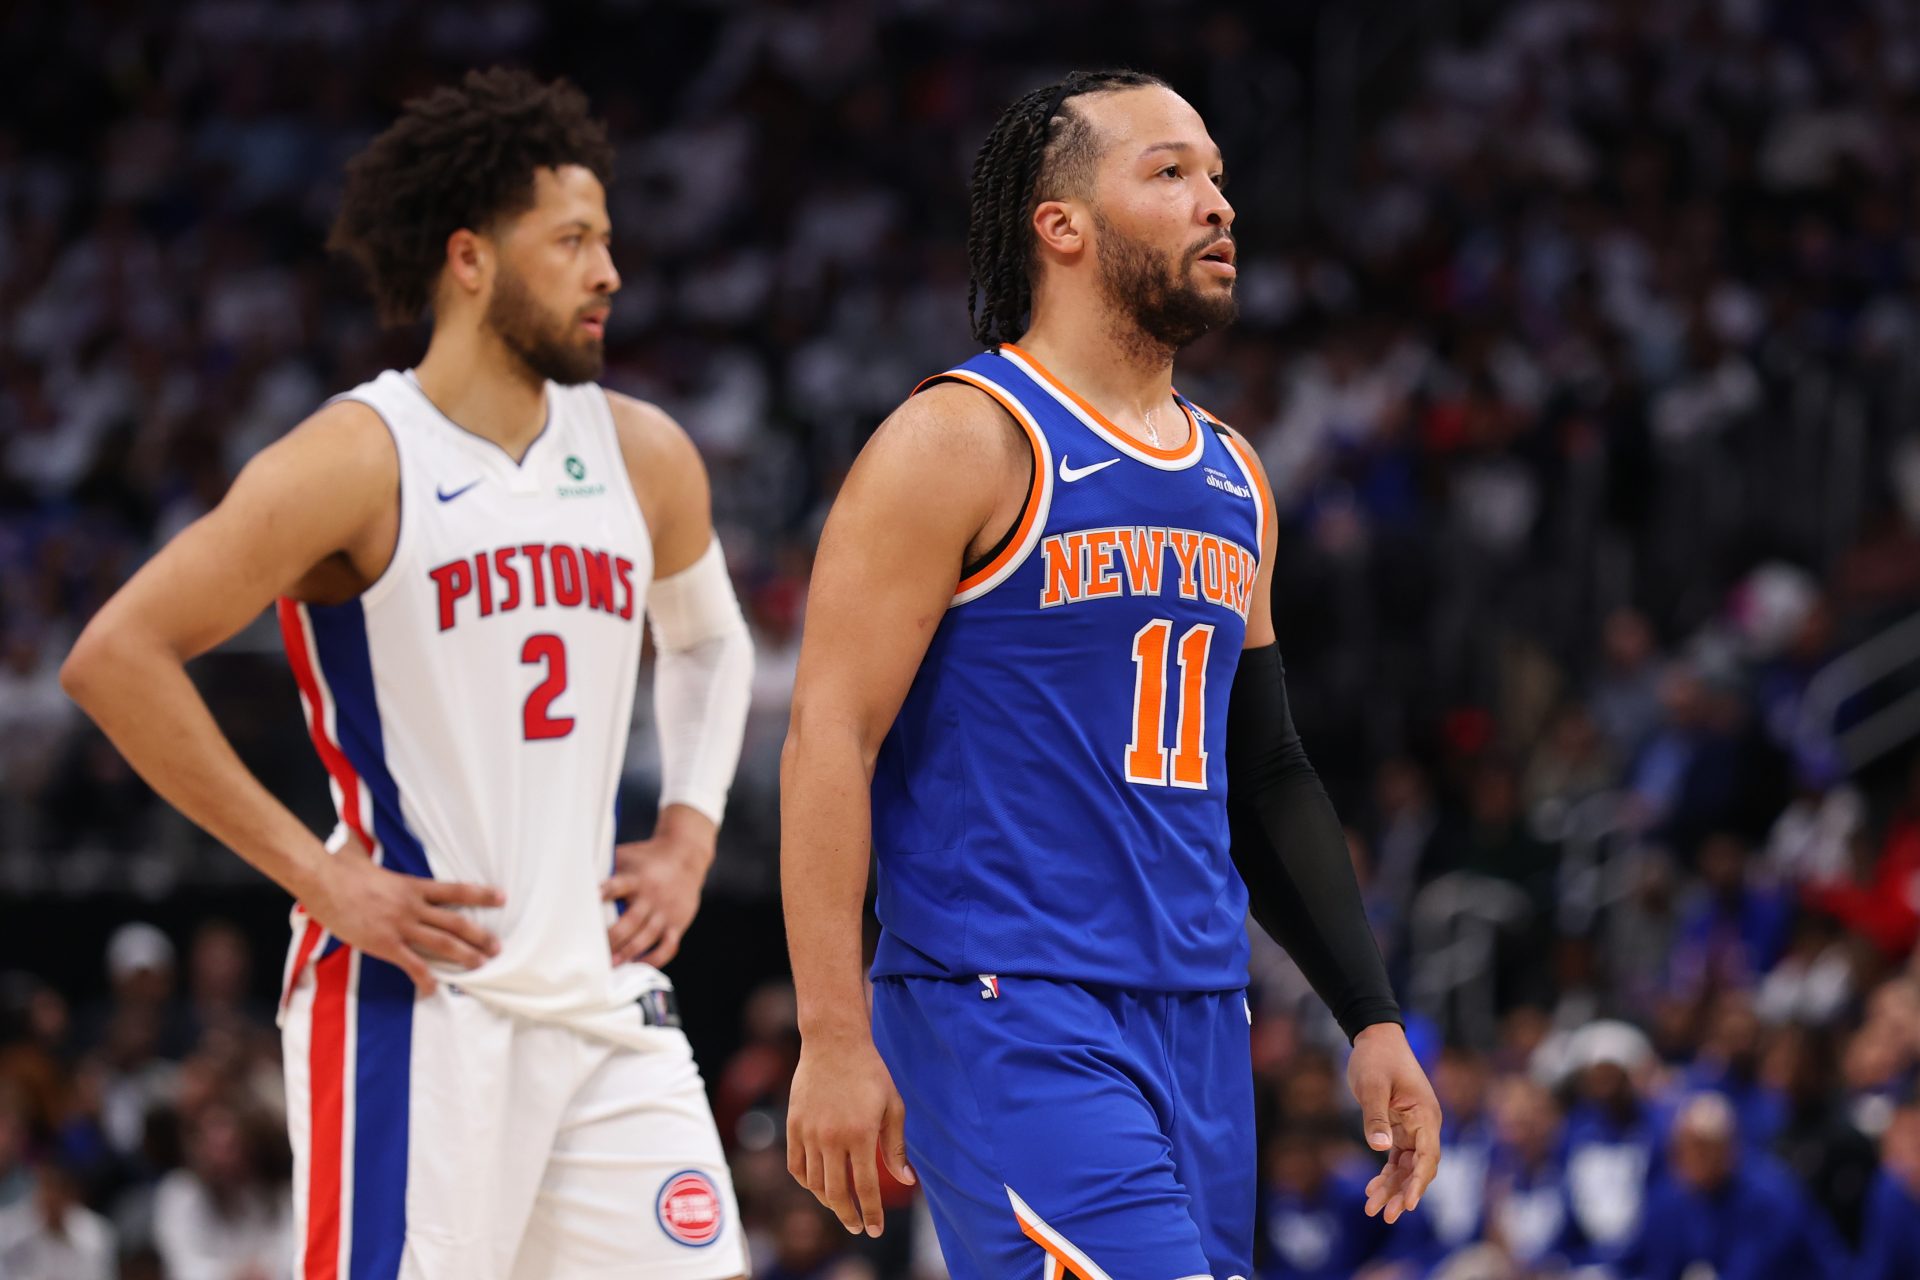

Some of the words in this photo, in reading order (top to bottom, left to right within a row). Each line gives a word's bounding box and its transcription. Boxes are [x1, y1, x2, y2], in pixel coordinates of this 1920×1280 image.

[1206, 474, 1224, 490] abu
[1224, 480, 1251, 498] dhabi
[428, 543, 634, 633] PISTONS
[1040, 526, 1166, 609] NEW
[519, 632, 576, 742] 2
[1124, 618, 1215, 790] 11
